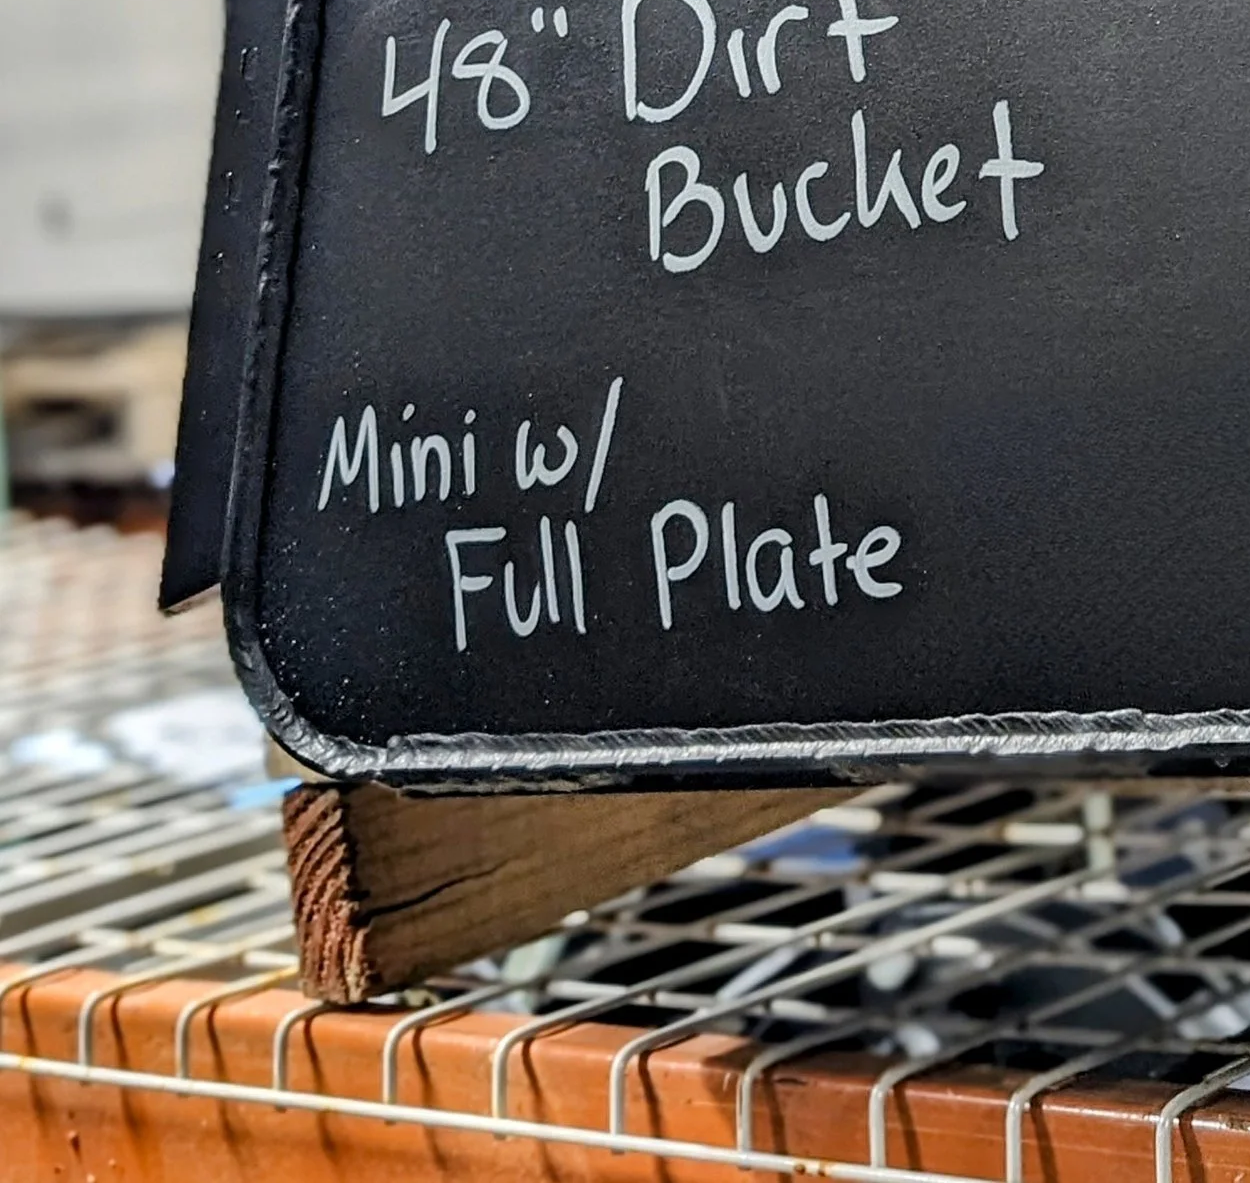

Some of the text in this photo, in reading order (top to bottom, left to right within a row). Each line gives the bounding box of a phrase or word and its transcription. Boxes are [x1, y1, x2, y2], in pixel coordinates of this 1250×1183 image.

[382, 7, 569, 154] 48"
[645, 100, 1044, 273] Bucket
[318, 377, 624, 513] Mini w/
[445, 493, 903, 652] Full Plate
